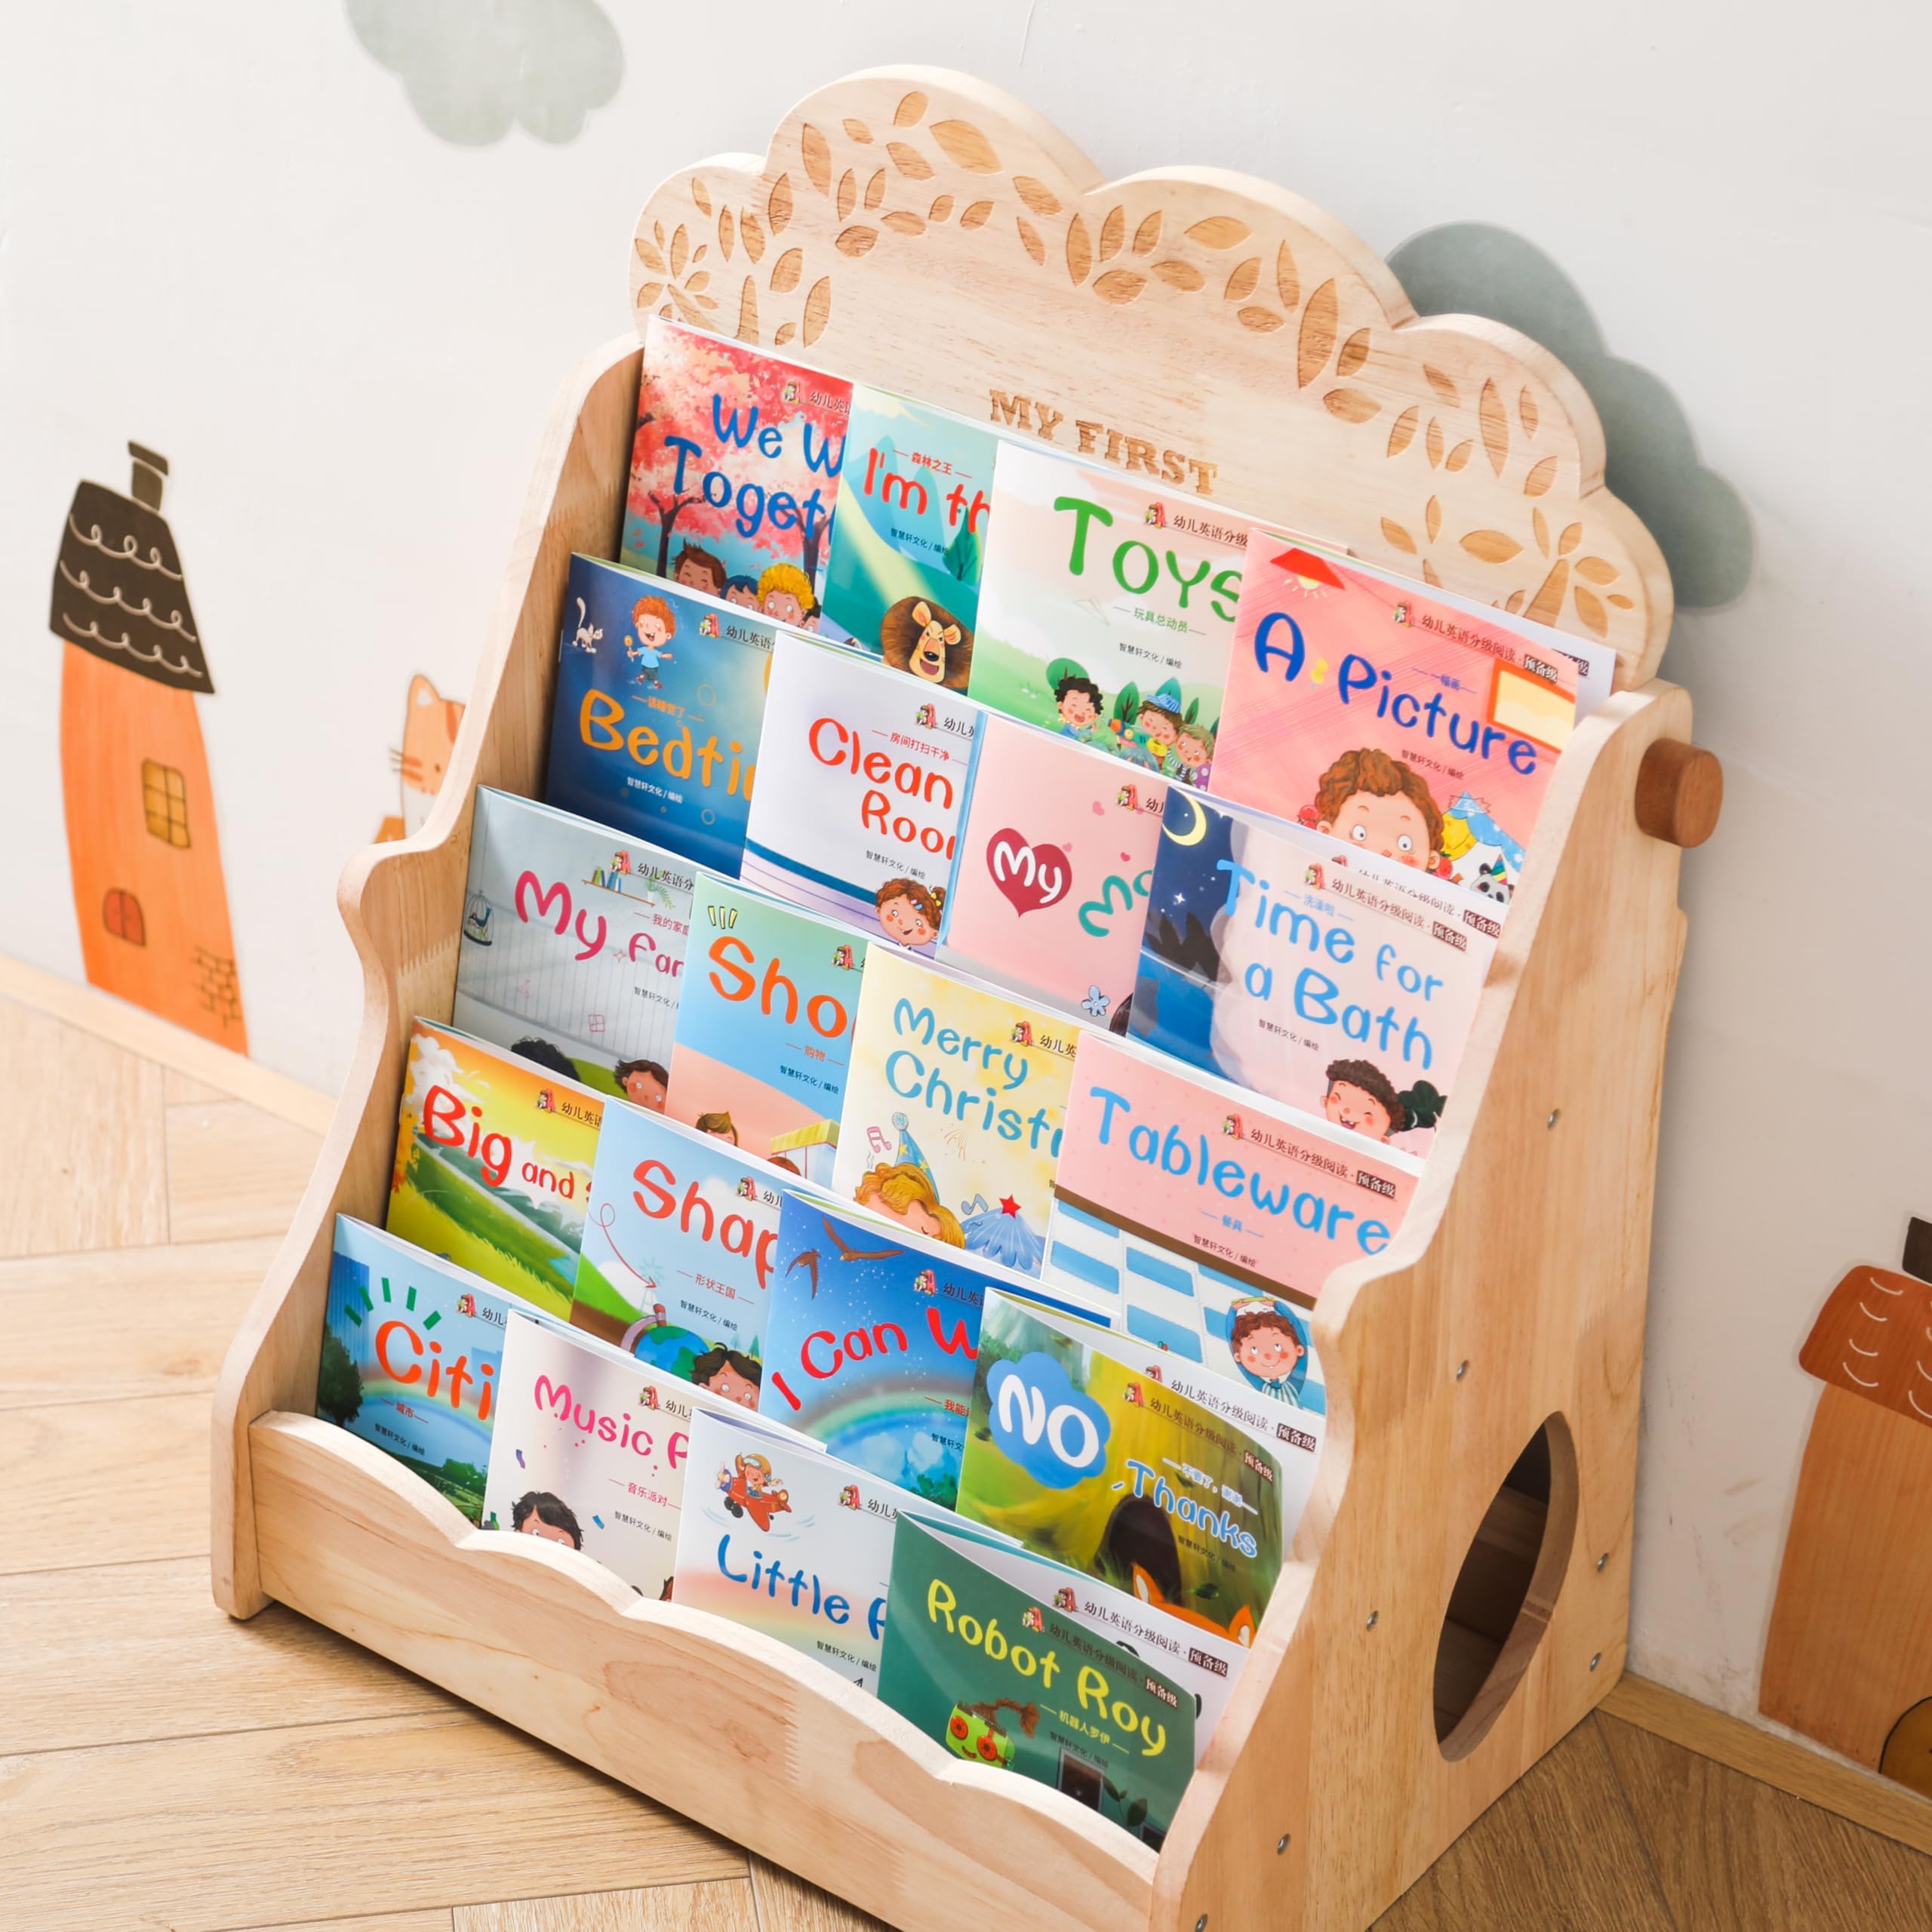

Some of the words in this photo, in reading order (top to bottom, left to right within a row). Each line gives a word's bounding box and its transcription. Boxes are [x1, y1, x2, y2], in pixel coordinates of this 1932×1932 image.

[712, 395, 782, 457] We
[989, 389, 1064, 441] MY
[1075, 419, 1218, 496] FIRST
[664, 435, 835, 546] Toget
[863, 448, 928, 515] I'm
[911, 452, 952, 475] 森林之王
[726, 625, 774, 650] 幼儿英语
[1134, 607, 1189, 634] 玩具总动员
[1254, 612, 1305, 681] A
[1338, 654, 1537, 775] Picture
[809, 718, 953, 810] Clean
[890, 732, 950, 761] 房间打扫干净
[993, 841, 1063, 903] My
[515, 870, 607, 961] My
[1217, 859, 1355, 964] Time
[1376, 943, 1444, 1001] for
[708, 936, 857, 1044] Sho
[1244, 962, 1272, 1001] a
[1294, 967, 1432, 1070] Bath
[804, 1045, 826, 1062] 购物
[894, 998, 1028, 1091] Merry
[423, 1084, 512, 1188] Big
[522, 1162, 574, 1199] and
[1090, 1086, 1390, 1255] Tableware
[1221, 1215, 1243, 1233] 餐具
[482, 1307, 507, 1327] 幼儿
[695, 1272, 736, 1300] 形状王国
[943, 1281, 983, 1306] 幼儿英
[375, 1321, 494, 1420] Citi
[771, 1371, 801, 1411] I
[801, 1322, 908, 1379] Can
[395, 1402, 414, 1418] 城市
[534, 1375, 654, 1457] Music
[666, 1400, 692, 1419] 幼儿
[931, 1433, 964, 1452] 智慧轩文
[628, 1481, 667, 1507] 音乐派对
[1126, 1458, 1257, 1558] Thanks
[718, 1534, 850, 1624] Little
[928, 1579, 1060, 1687] Robot
[1078, 1666, 1166, 1756] Roy
[1059, 1710, 1110, 1744] 机器人罗伊
